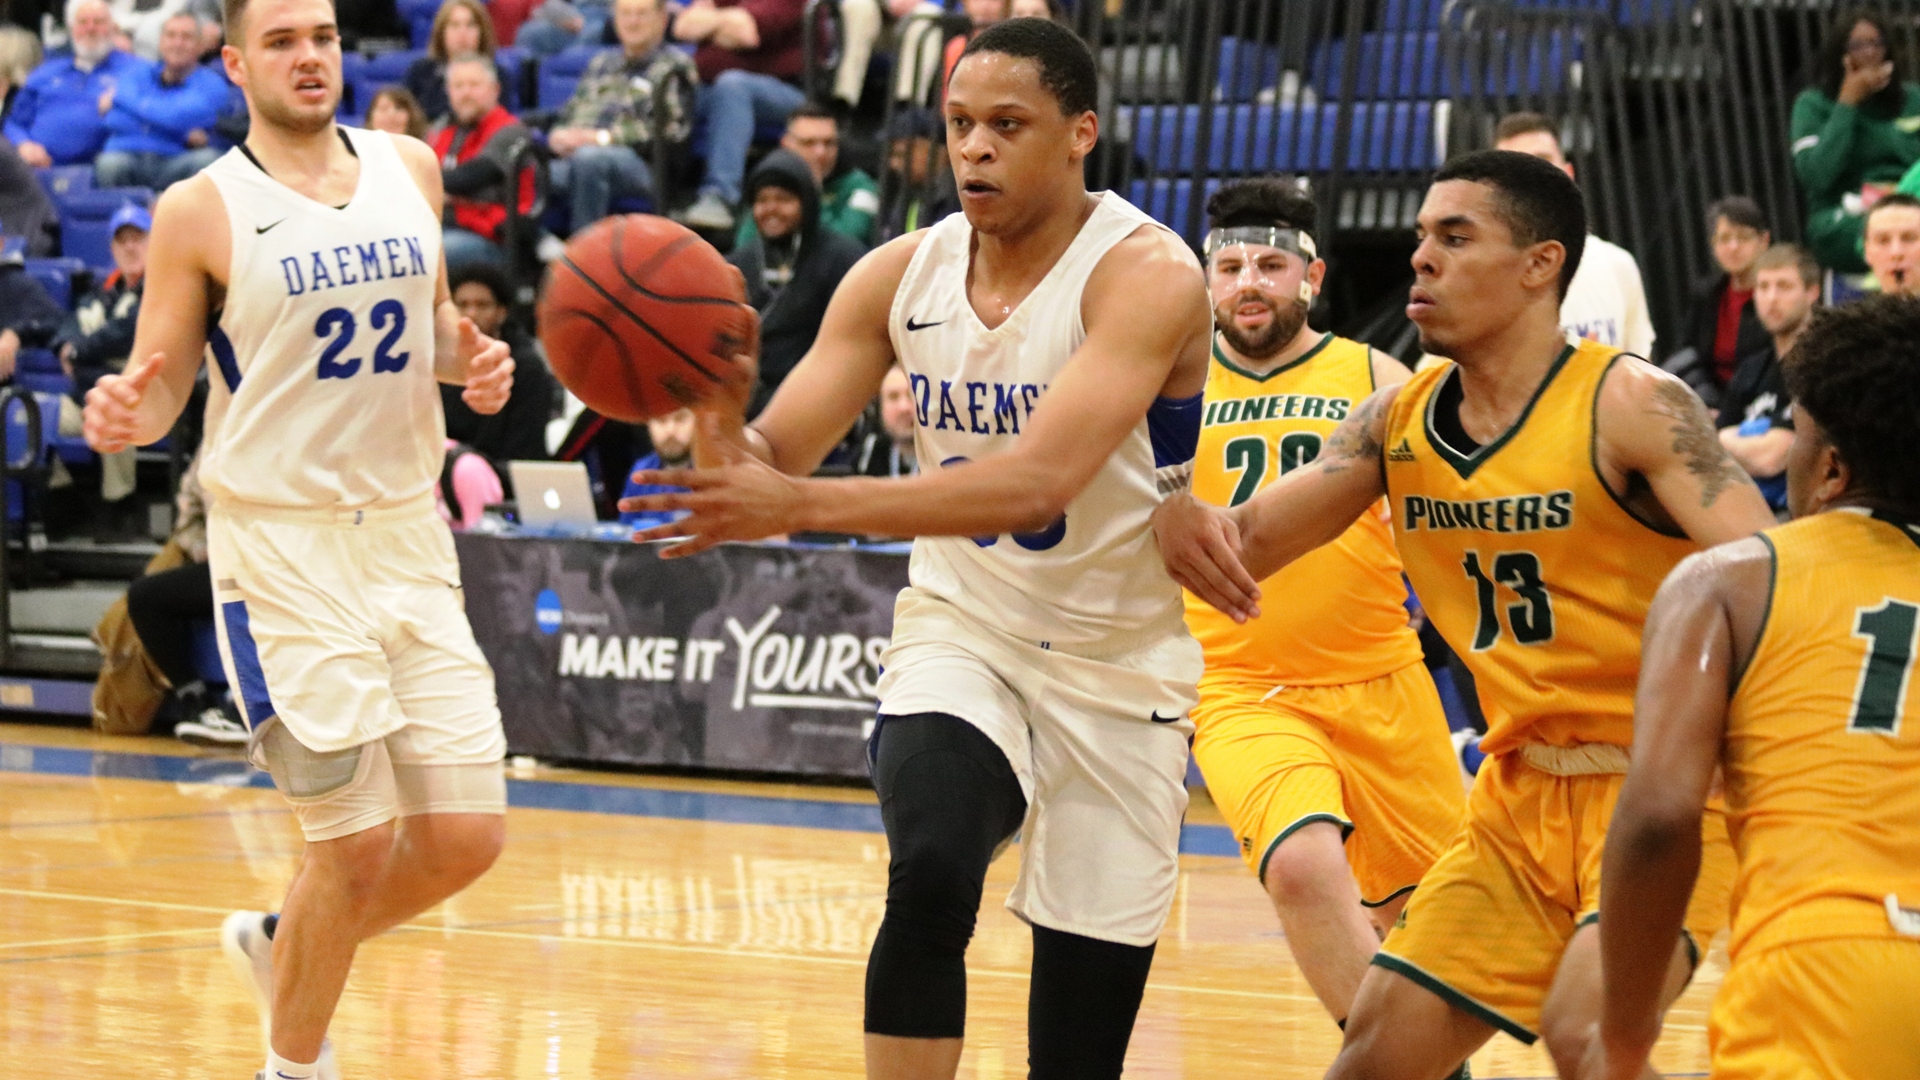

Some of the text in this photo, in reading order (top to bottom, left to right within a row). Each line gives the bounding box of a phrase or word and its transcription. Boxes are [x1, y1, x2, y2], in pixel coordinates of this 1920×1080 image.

[280, 237, 428, 296] DAEMEN
[314, 298, 410, 380] 22
[910, 373, 1048, 435] DAEME
[1203, 394, 1351, 427] IONEERS
[1404, 490, 1574, 533] PIONEERS
[1463, 550, 1556, 651] 13
[558, 633, 678, 681] MAKE
[683, 639, 725, 683] IT
[1847, 596, 1920, 737] 1
